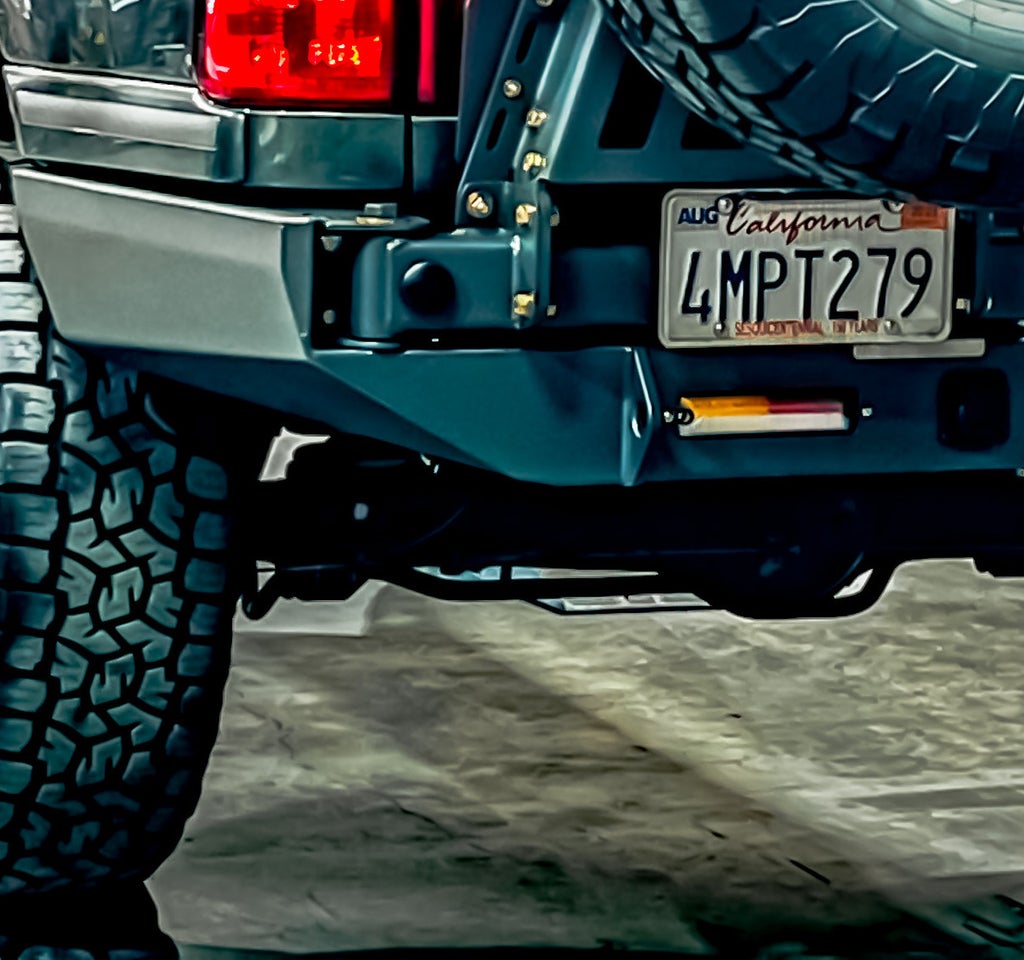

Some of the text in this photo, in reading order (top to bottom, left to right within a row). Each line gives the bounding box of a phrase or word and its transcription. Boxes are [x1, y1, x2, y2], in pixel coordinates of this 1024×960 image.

[678, 207, 719, 225] AUG
[727, 200, 903, 246] California
[680, 247, 933, 323] 4MPT279
